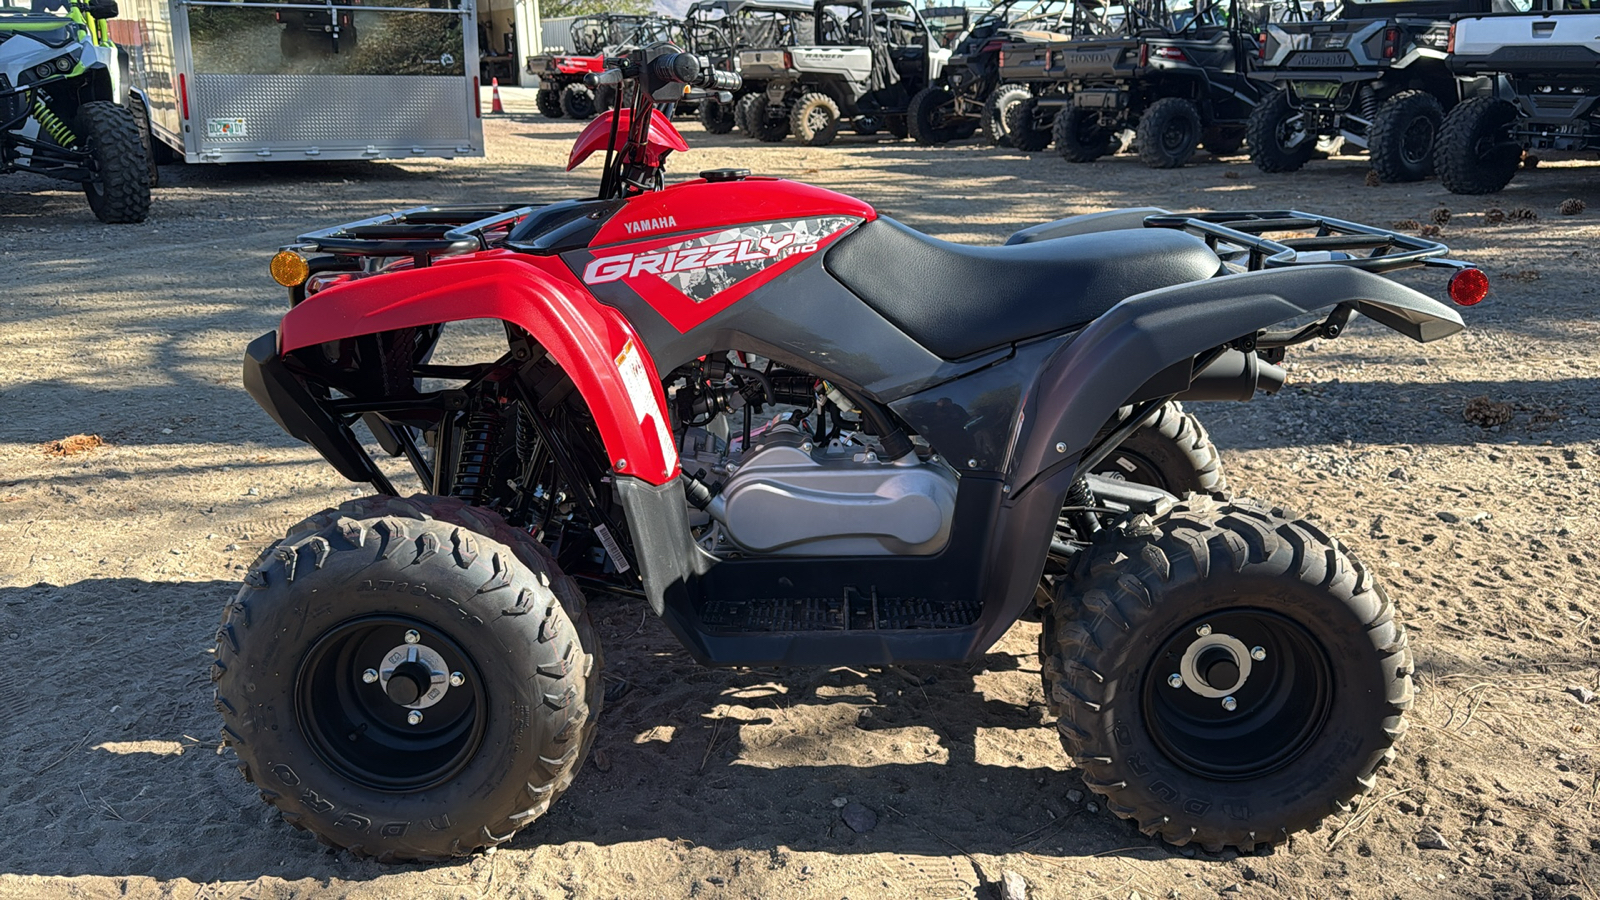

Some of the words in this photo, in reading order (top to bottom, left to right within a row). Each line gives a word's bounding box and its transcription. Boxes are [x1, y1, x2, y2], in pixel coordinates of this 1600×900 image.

[1069, 53, 1112, 64] HONDA
[624, 215, 677, 234] YAMAHA
[788, 243, 818, 254] 110
[582, 233, 796, 285] GRIZZLY
